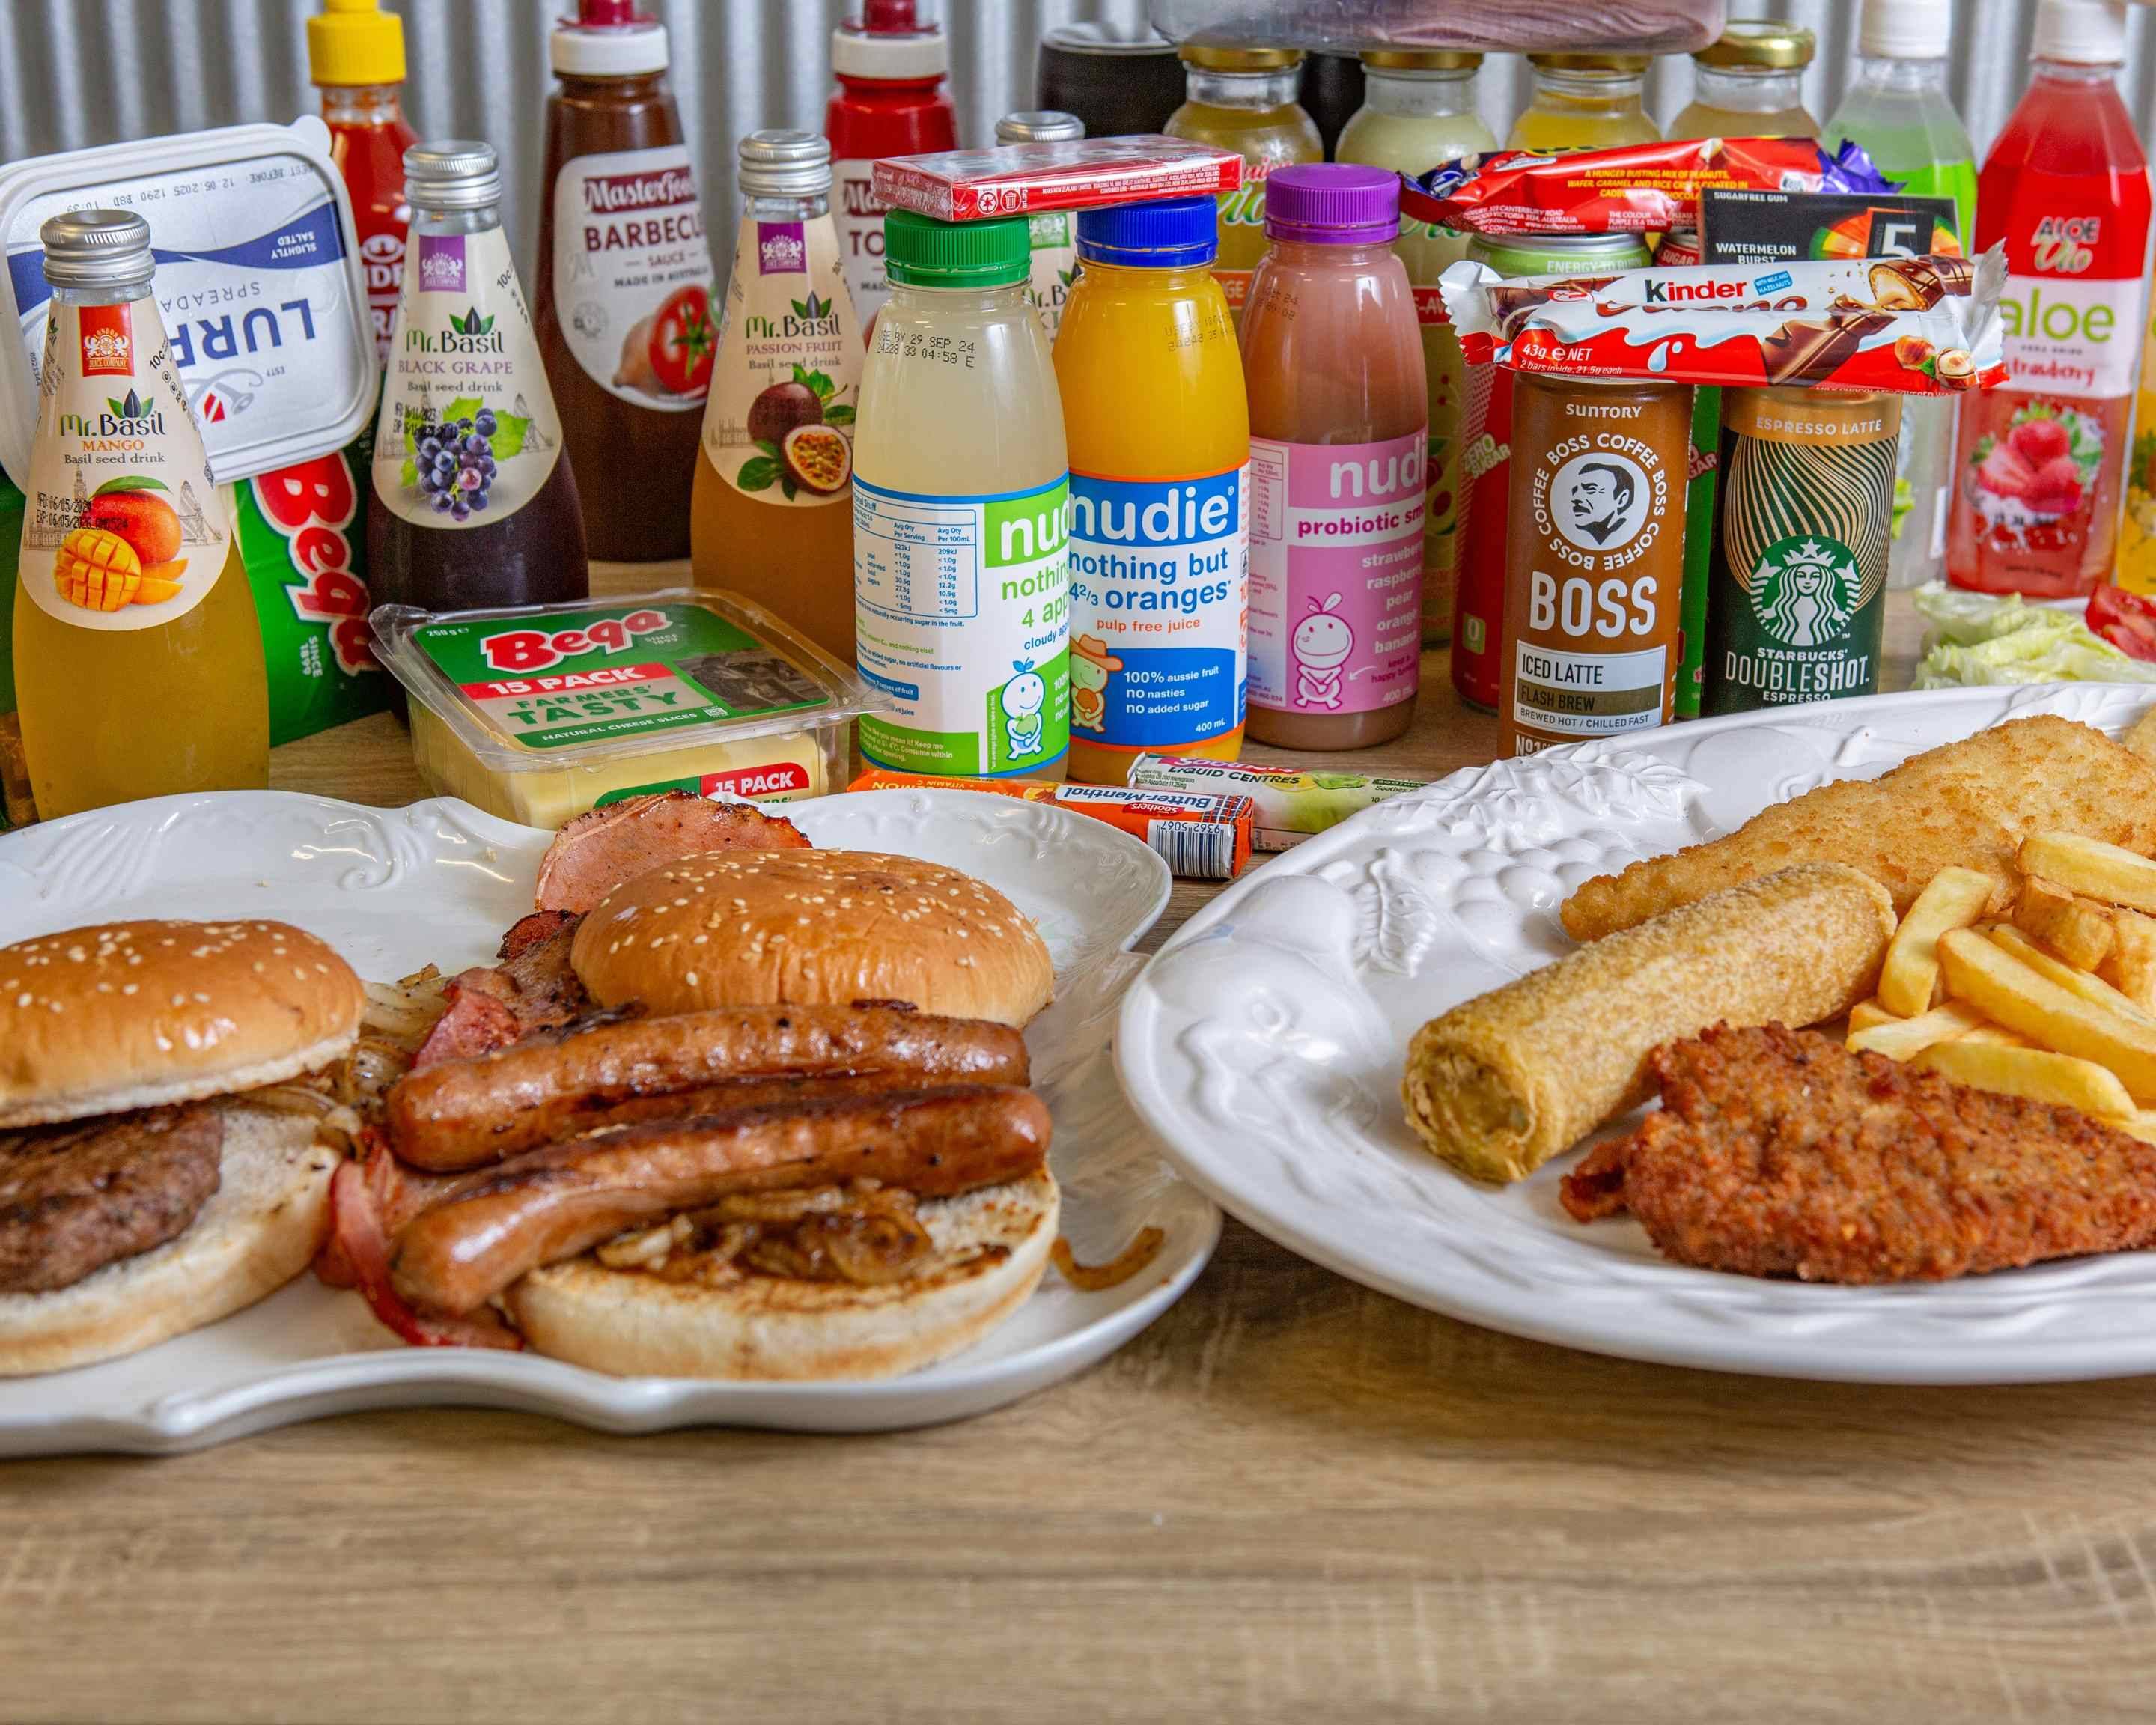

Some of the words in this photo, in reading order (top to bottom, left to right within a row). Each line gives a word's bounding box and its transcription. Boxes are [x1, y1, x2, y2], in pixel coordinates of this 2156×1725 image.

[1592, 170, 1626, 178] HUNGER
[1627, 170, 1660, 178] BUSTING
[1596, 180, 1632, 188] CARAMEL
[1653, 180, 1672, 189] RICE
[1702, 180, 1735, 189] COATED
[1713, 191, 1764, 203] SUGARFREE
[1767, 194, 1788, 203] GUM
[277, 231, 316, 246] SALTED
[584, 214, 707, 252] BARBECU
[1881, 222, 1918, 258] 5
[270, 243, 318, 261] SLIGHTLY
[1661, 249, 1696, 266] SUGAR
[1715, 242, 1797, 256] WATERMELON
[1737, 255, 1777, 265] BURST
[159, 281, 261, 314] SPREADA
[1643, 278, 1748, 304] Kinder
[2000, 287, 2116, 344] aloe
[170, 299, 317, 369] LURP
[746, 313, 841, 339] Mr.Basil
[405, 328, 505, 355] Mr.Basil
[746, 342, 802, 355] PASSION
[806, 341, 844, 353] FRUIT
[910, 334, 923, 345] 29
[929, 336, 951, 349] SEP
[958, 341, 975, 354] 24
[904, 345, 916, 357] 33
[922, 347, 958, 365] 04:58
[965, 356, 975, 368] E
[1521, 342, 1548, 359] 43g
[1568, 347, 1594, 362] NET
[398, 360, 446, 374] BLACK
[452, 361, 514, 374] GRAPE
[749, 359, 775, 370] Basil
[810, 358, 841, 368] drink
[1520, 359, 1527, 369] 2
[1527, 360, 1547, 372] bars
[1576, 365, 1601, 376] 21.5g
[1601, 365, 1623, 375] each
[406, 381, 432, 392] Basil
[434, 381, 464, 392] seed
[467, 380, 504, 392] drink
[59, 413, 167, 437] Mr.Basil
[1755, 416, 1837, 436] ESPRESSO
[1841, 419, 1882, 436] LATTE
[82, 439, 144, 452] MANGO
[1545, 433, 1592, 466] BOSS
[1596, 432, 1660, 469] COFFEE
[64, 454, 92, 465] Basil
[95, 454, 126, 464] seed
[130, 452, 165, 463] drink
[1532, 466, 1553, 536] COFFEE
[1651, 468, 1668, 517] BOSS
[951, 527, 962, 535] Qty
[1297, 512, 1400, 538] probiotic
[1548, 538, 1595, 571] BOSS
[1602, 522, 1660, 571] COFFEE
[1068, 550, 1178, 586] nothing
[1188, 547, 1228, 577] but
[938, 582, 956, 590] 12.2g
[1386, 590, 1414, 611] pear
[1529, 571, 1658, 639] BOSS
[1020, 608, 1035, 628] 4
[1096, 619, 1127, 633] pulp
[1131, 620, 1163, 632] free
[1168, 618, 1201, 633] juice
[479, 609, 673, 675] Bega
[1023, 628, 1057, 651] cloudy
[299, 642, 313, 677] 1899
[308, 635, 324, 678] SINCE
[1756, 647, 1848, 663] STARBUCKS
[930, 663, 954, 672] flavours
[1123, 670, 1165, 684] 100%
[1167, 672, 1199, 683] aussie
[1202, 666, 1219, 678] fruit
[1521, 653, 1552, 679] ICED
[1554, 662, 1604, 685] LATTE
[487, 678, 532, 695] 15
[537, 666, 647, 692] PACK
[515, 684, 651, 708] FARMERS'
[1126, 688, 1145, 699] no
[1147, 688, 1186, 699] nasties
[1520, 684, 1556, 709] FLASH
[1557, 693, 1596, 712] BREW
[1762, 690, 1831, 703] ESPRESSO
[506, 691, 678, 725] TASTY
[1126, 703, 1145, 714] no
[1147, 703, 1180, 714] added
[1182, 699, 1210, 713] sugar
[541, 726, 604, 741] NATURAL
[607, 717, 655, 731] CHEESE
[659, 712, 698, 725] SLICES
[1195, 720, 1213, 733] 400
[1213, 717, 1226, 729] mL
[1520, 707, 1556, 725] BREWED
[1557, 716, 1578, 728] HOT
[1586, 717, 1627, 728] CHILLED
[1627, 714, 1650, 726] FAST
[914, 740, 931, 750] Keep
[931, 751, 954, 759] within
[714, 779, 736, 795] 15
[740, 770, 795, 795] PACK
[928, 780, 965, 789] VITAMIN
[1168, 766, 1228, 778] LIQUID
[1228, 771, 1301, 785] CENTRES
[1063, 786, 1212, 809] Butter-Menthol
[1160, 821, 1188, 832] 5067
[1193, 823, 1221, 834] 9362
